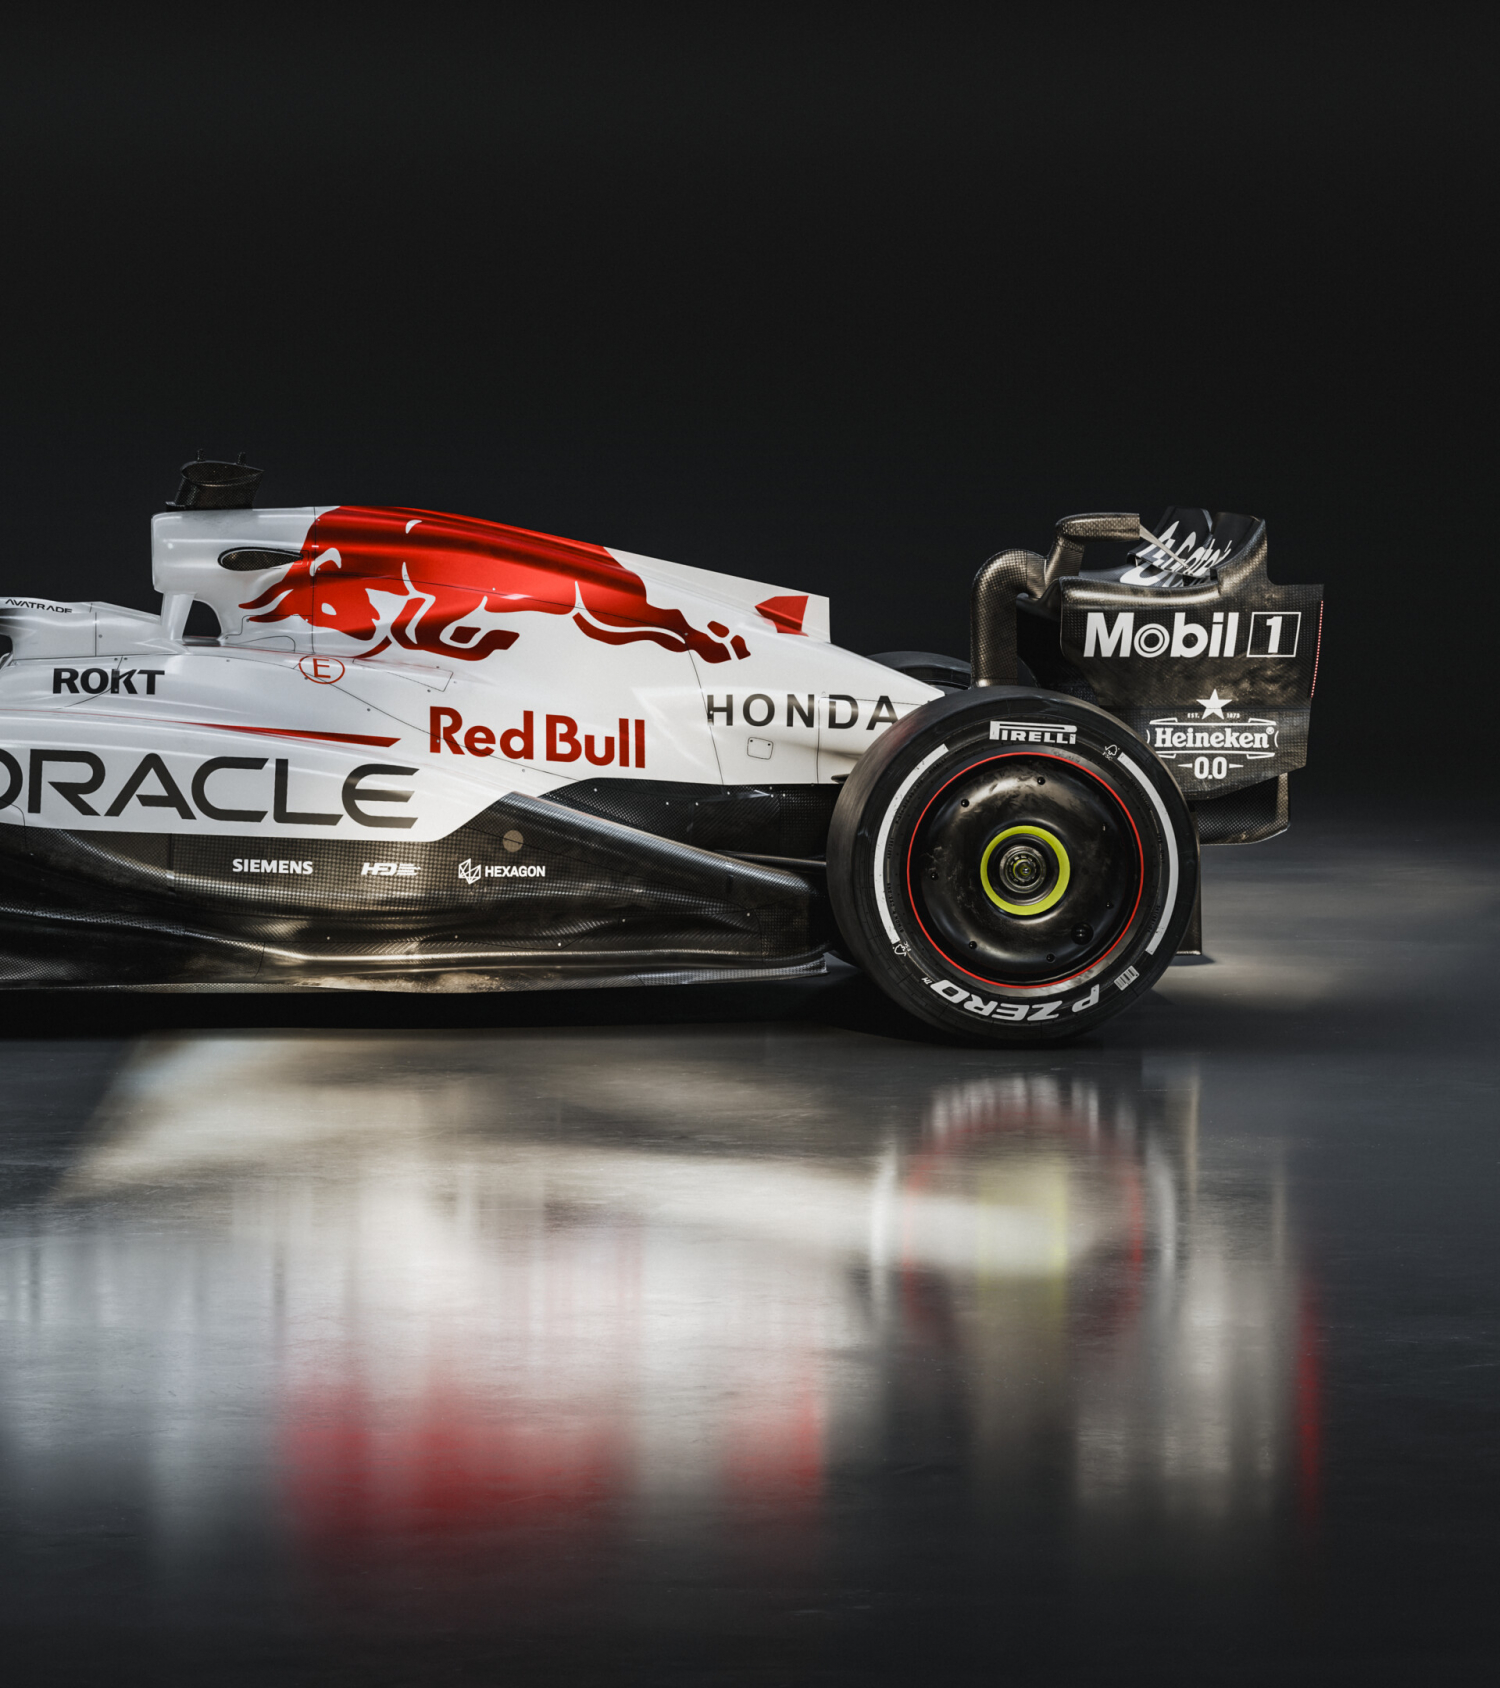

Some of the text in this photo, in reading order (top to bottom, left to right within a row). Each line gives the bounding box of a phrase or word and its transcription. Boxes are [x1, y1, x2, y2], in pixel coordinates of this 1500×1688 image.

[5, 599, 73, 614] AVATRADE
[1083, 612, 1283, 658] Mobil 1
[313, 658, 331, 679] E
[53, 668, 165, 695] ROKT
[706, 693, 900, 731] HONDA
[429, 706, 645, 768] Red Bull
[989, 720, 1077, 745] PIRELLI
[1154, 727, 1274, 749] Heineken
[1194, 756, 1228, 780] 0.0
[232, 858, 314, 875] SIEMENS
[485, 866, 546, 877] HEXAGON
[930, 979, 1063, 1022] ZERO
[1071, 983, 1100, 1012] P
